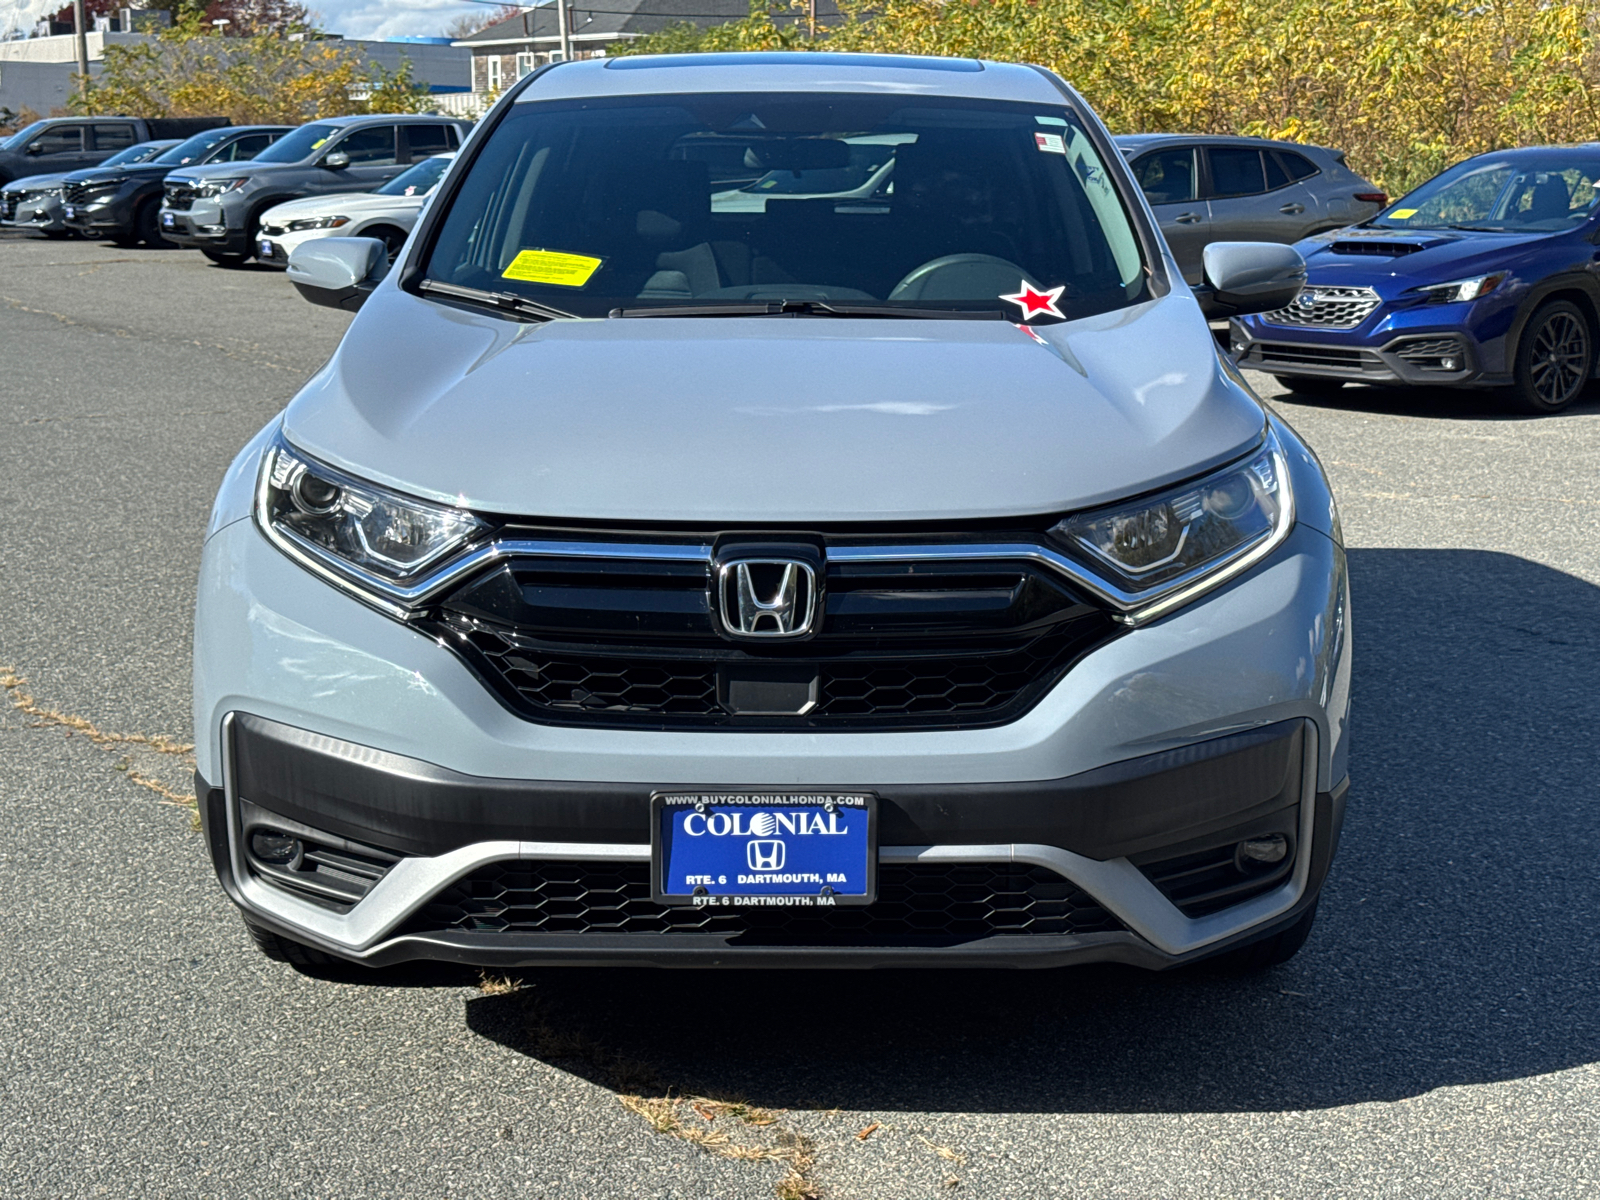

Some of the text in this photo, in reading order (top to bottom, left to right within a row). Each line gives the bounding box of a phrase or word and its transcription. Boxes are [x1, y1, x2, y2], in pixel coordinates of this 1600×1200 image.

[665, 795, 864, 806] WWW.BUYCOLONIALHONDA.COM
[683, 812, 848, 837] COLONIAL
[686, 873, 847, 885] RTE. 6 DARTMOUTH, MA
[693, 896, 836, 907] RTE. 6 DARTMOUTH, MA
